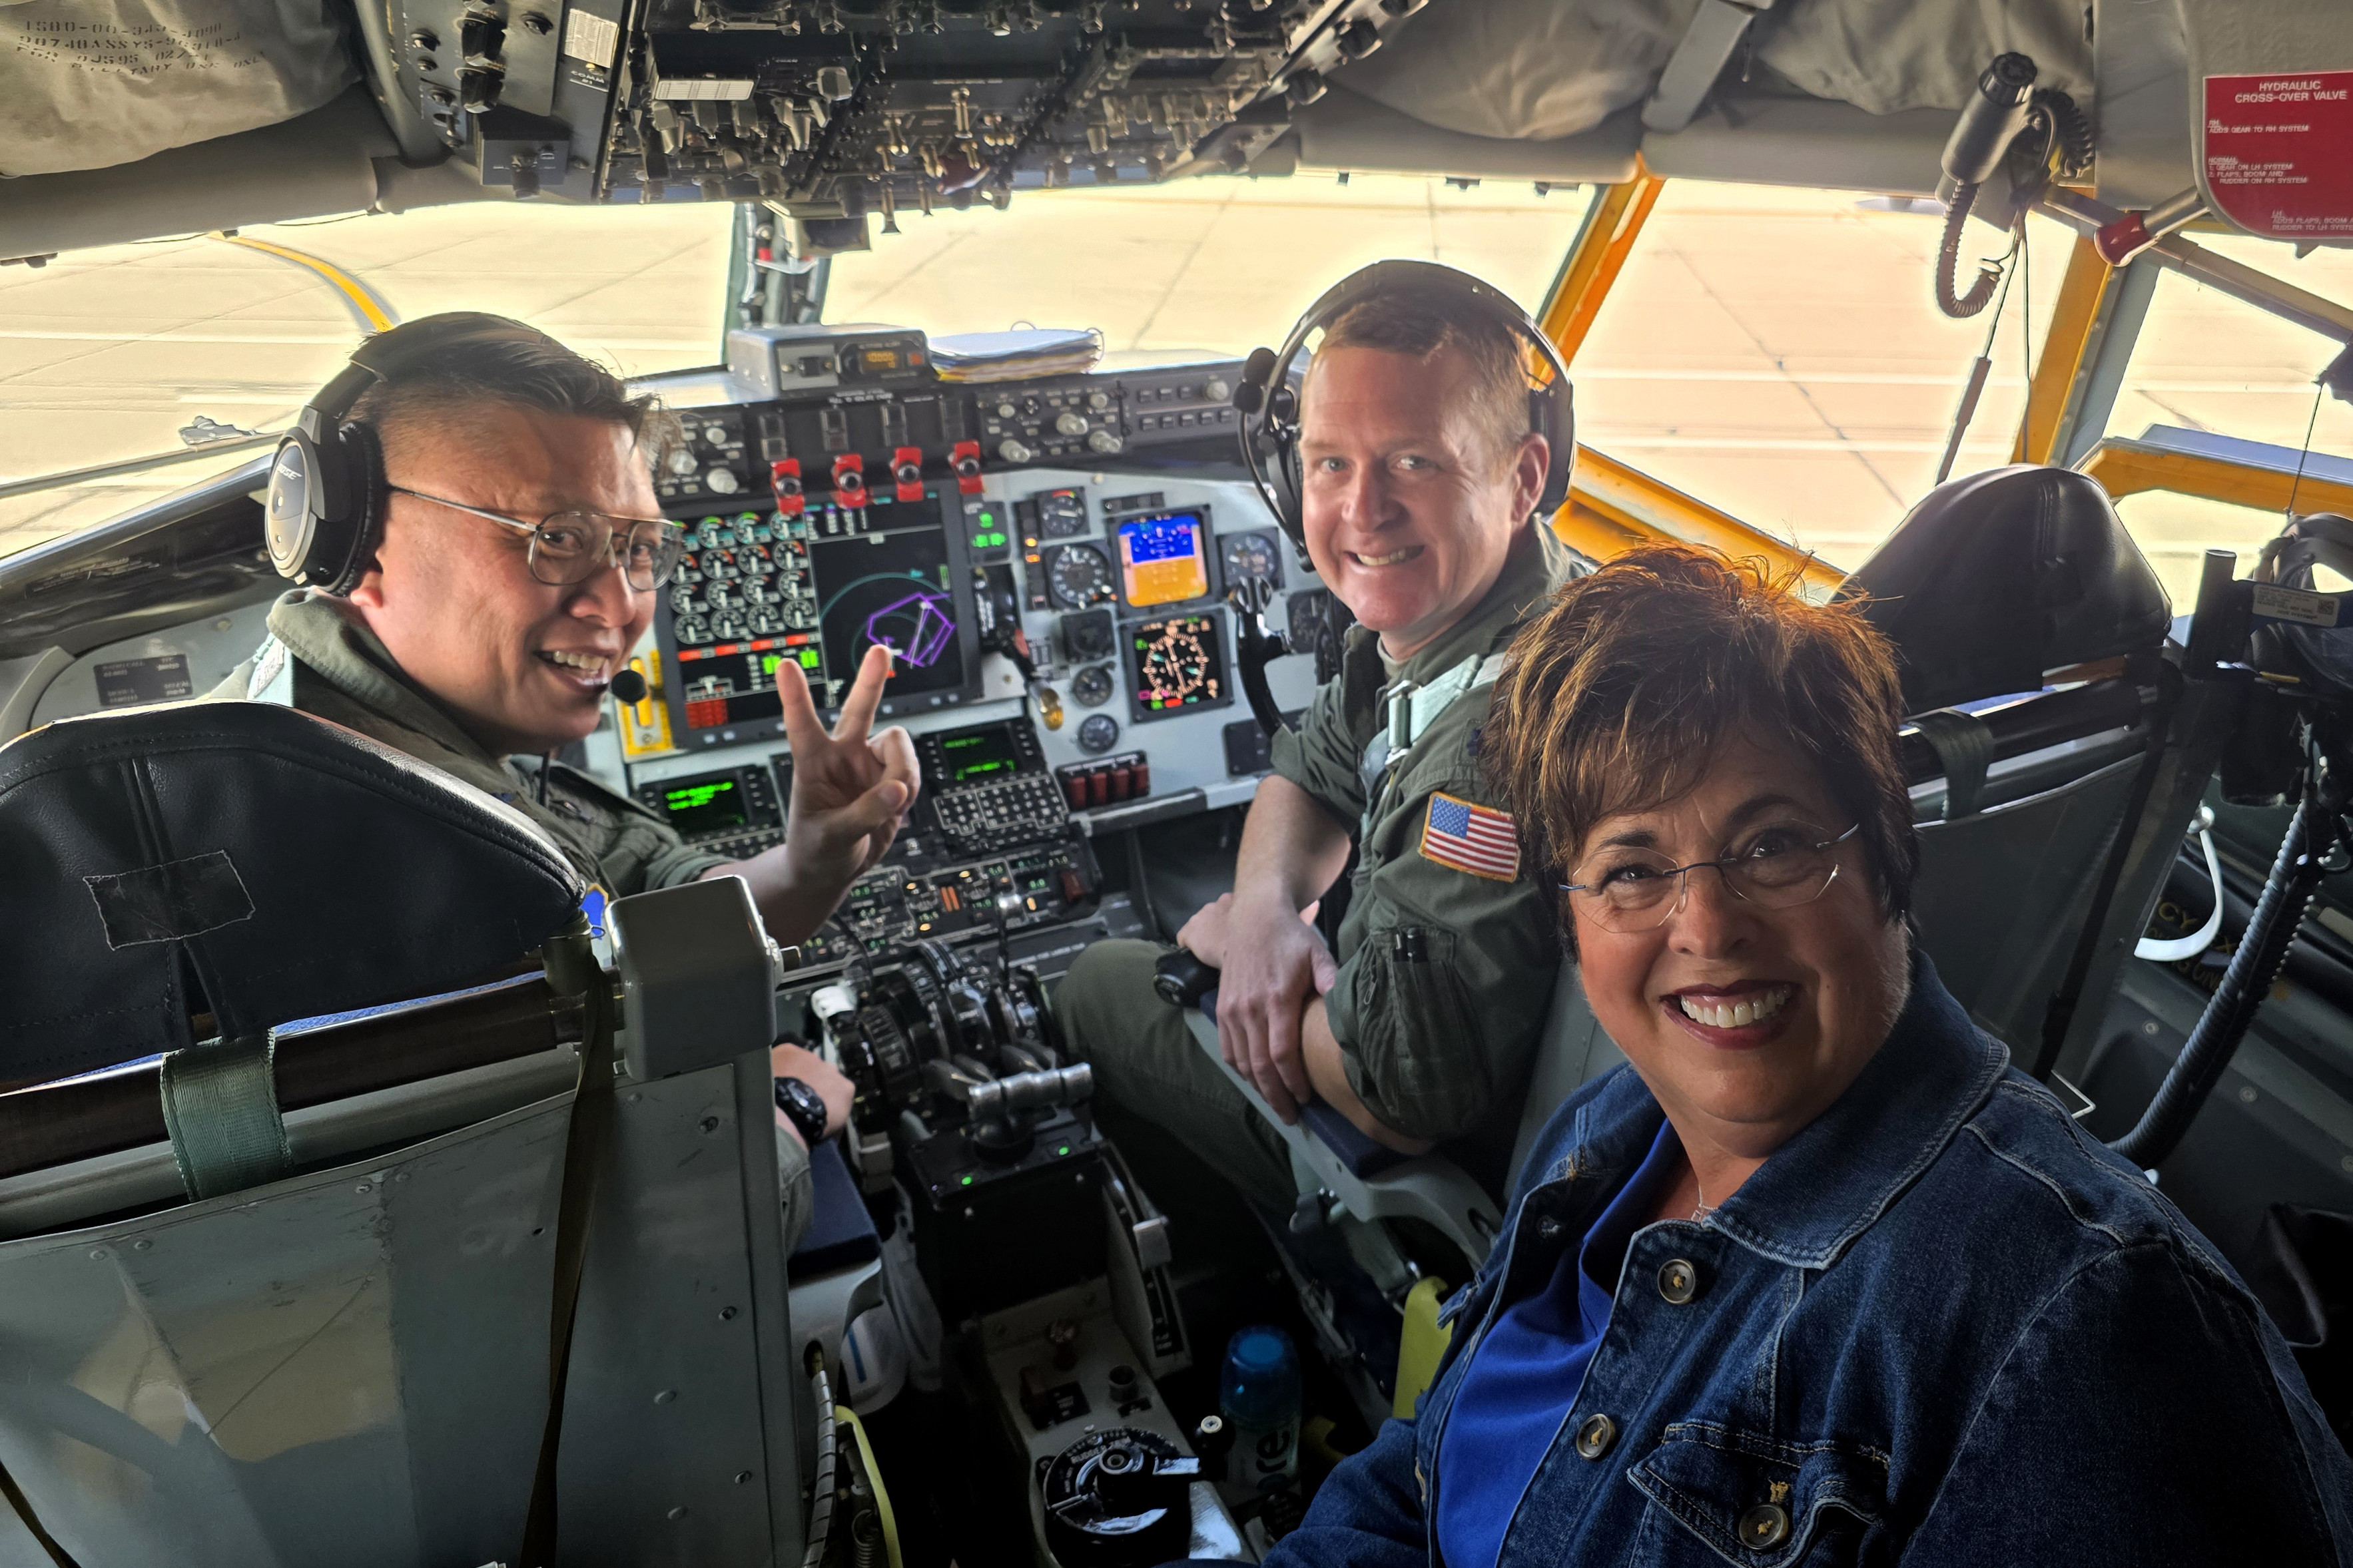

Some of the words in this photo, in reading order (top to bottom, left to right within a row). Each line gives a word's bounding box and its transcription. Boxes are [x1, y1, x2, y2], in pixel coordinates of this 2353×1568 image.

[571, 71, 604, 83] COMM
[2259, 81, 2322, 91] HYDRAULIC
[2234, 93, 2309, 103] CROSS-OVER
[2314, 91, 2348, 101] VALVE
[276, 463, 302, 480] BOSE
